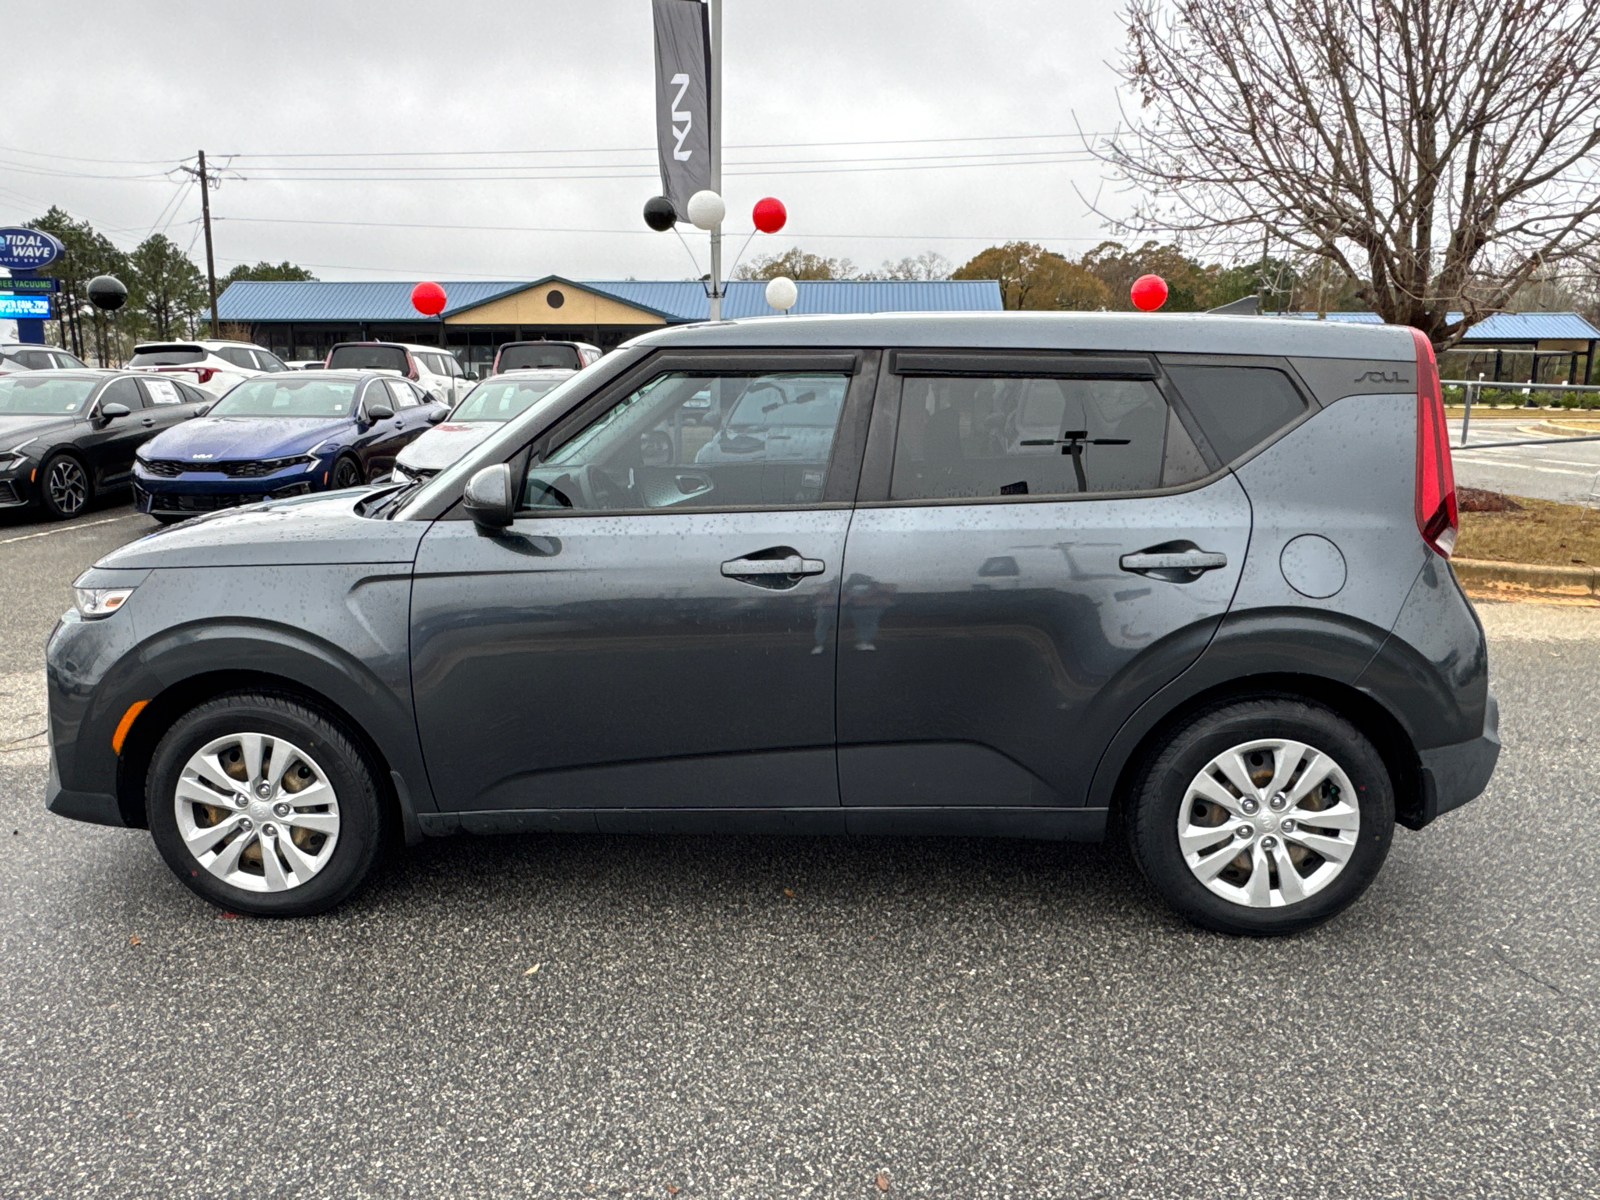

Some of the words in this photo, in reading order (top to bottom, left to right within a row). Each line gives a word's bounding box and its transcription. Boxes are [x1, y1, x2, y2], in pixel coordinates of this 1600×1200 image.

[5, 234, 42, 246] TIDAL
[12, 246, 51, 258] WAVE
[14, 280, 52, 288] VACUUMS
[1353, 371, 1409, 383] SOUL
